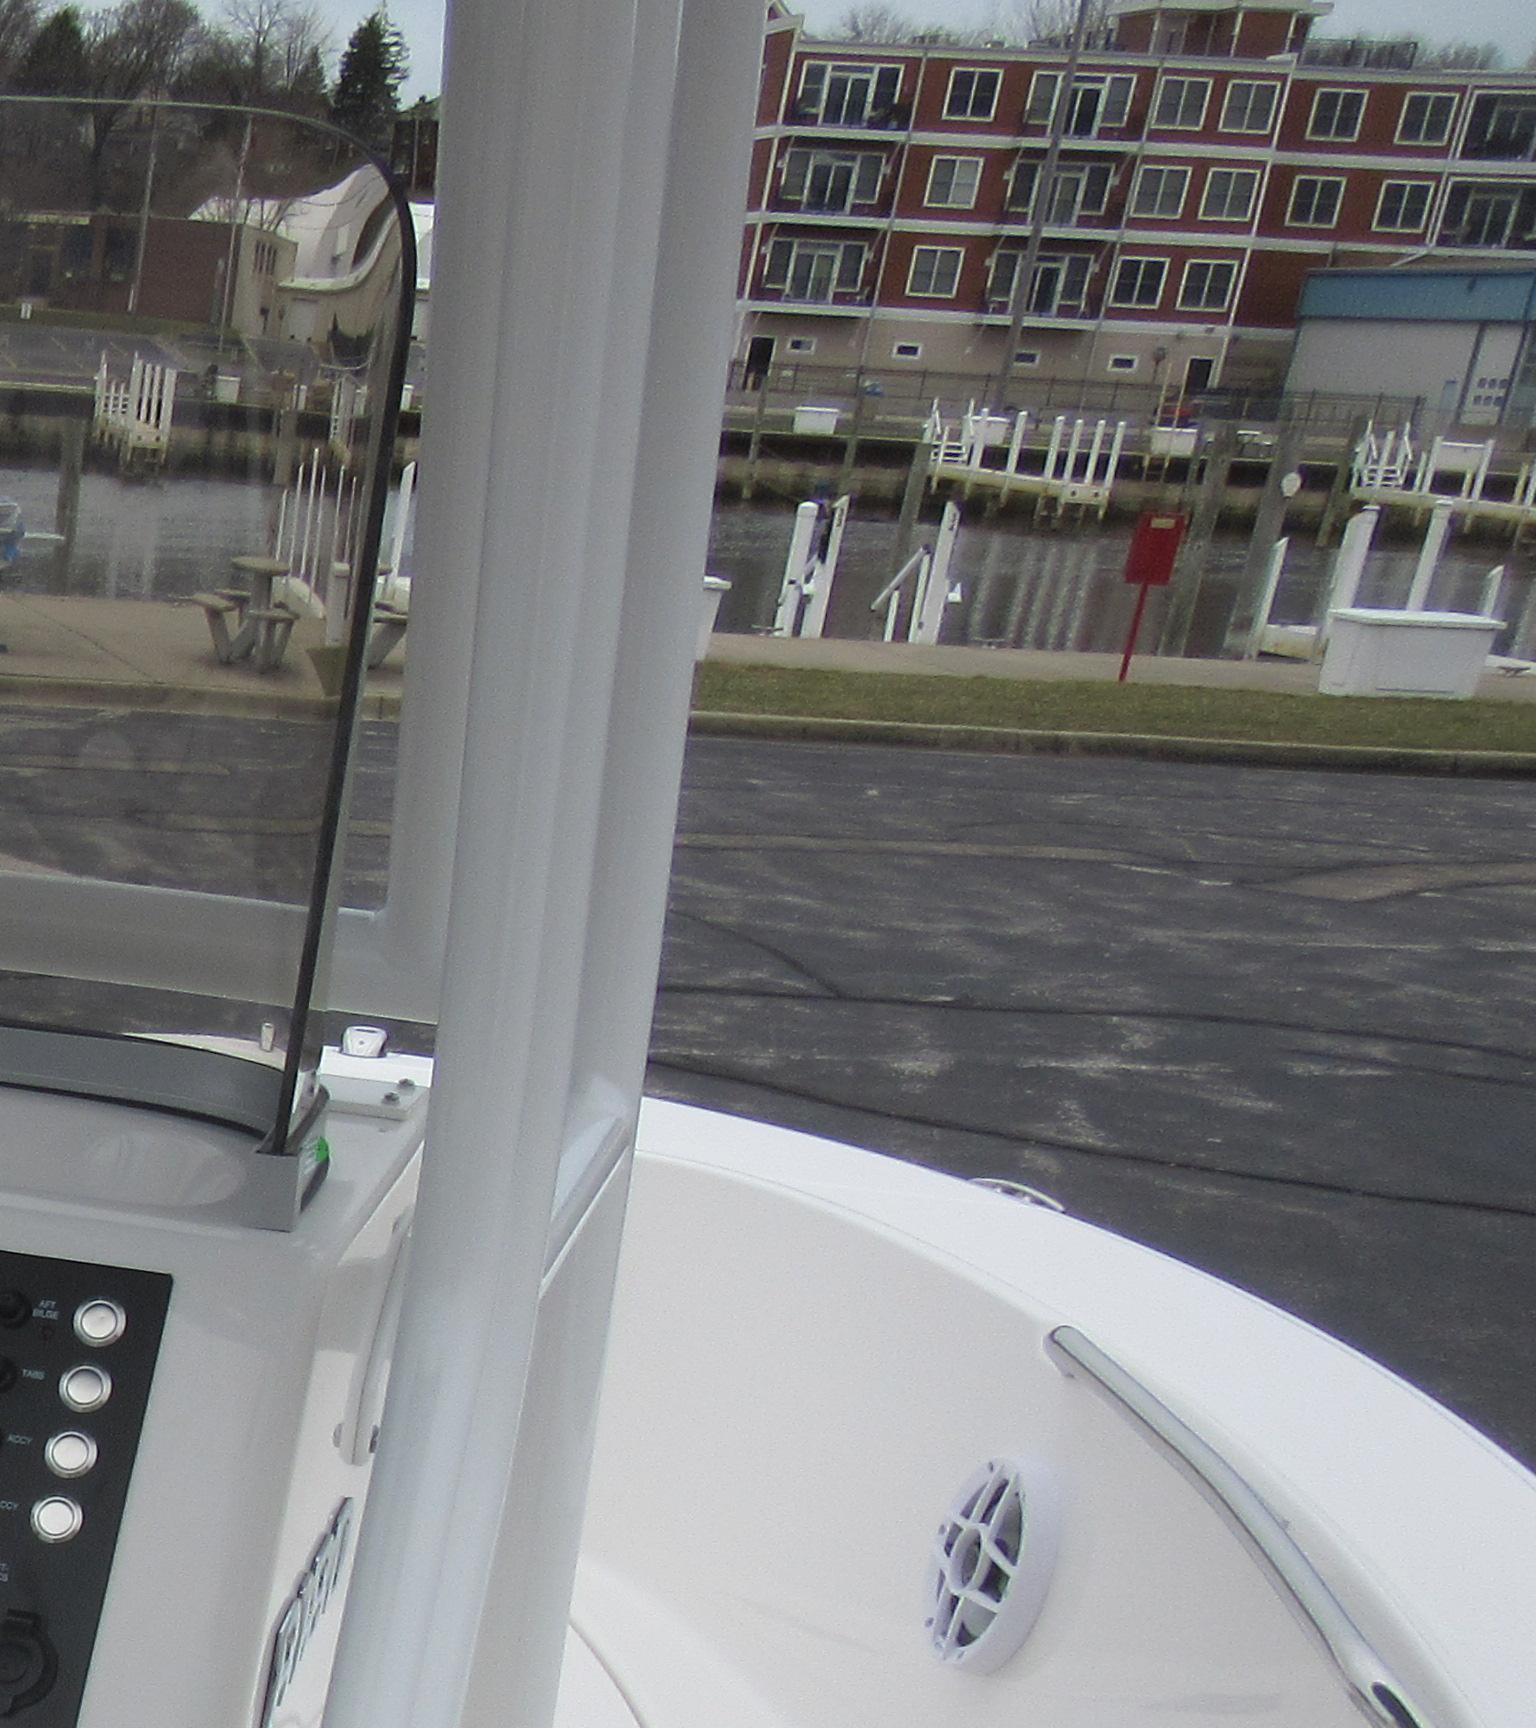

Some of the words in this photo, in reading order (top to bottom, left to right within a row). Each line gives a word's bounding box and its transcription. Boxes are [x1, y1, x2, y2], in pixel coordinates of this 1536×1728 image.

[39, 1300, 56, 1309] AFT
[32, 1308, 58, 1320] BILGE
[23, 1369, 44, 1380] TABS
[8, 1434, 32, 1445] ACCY
